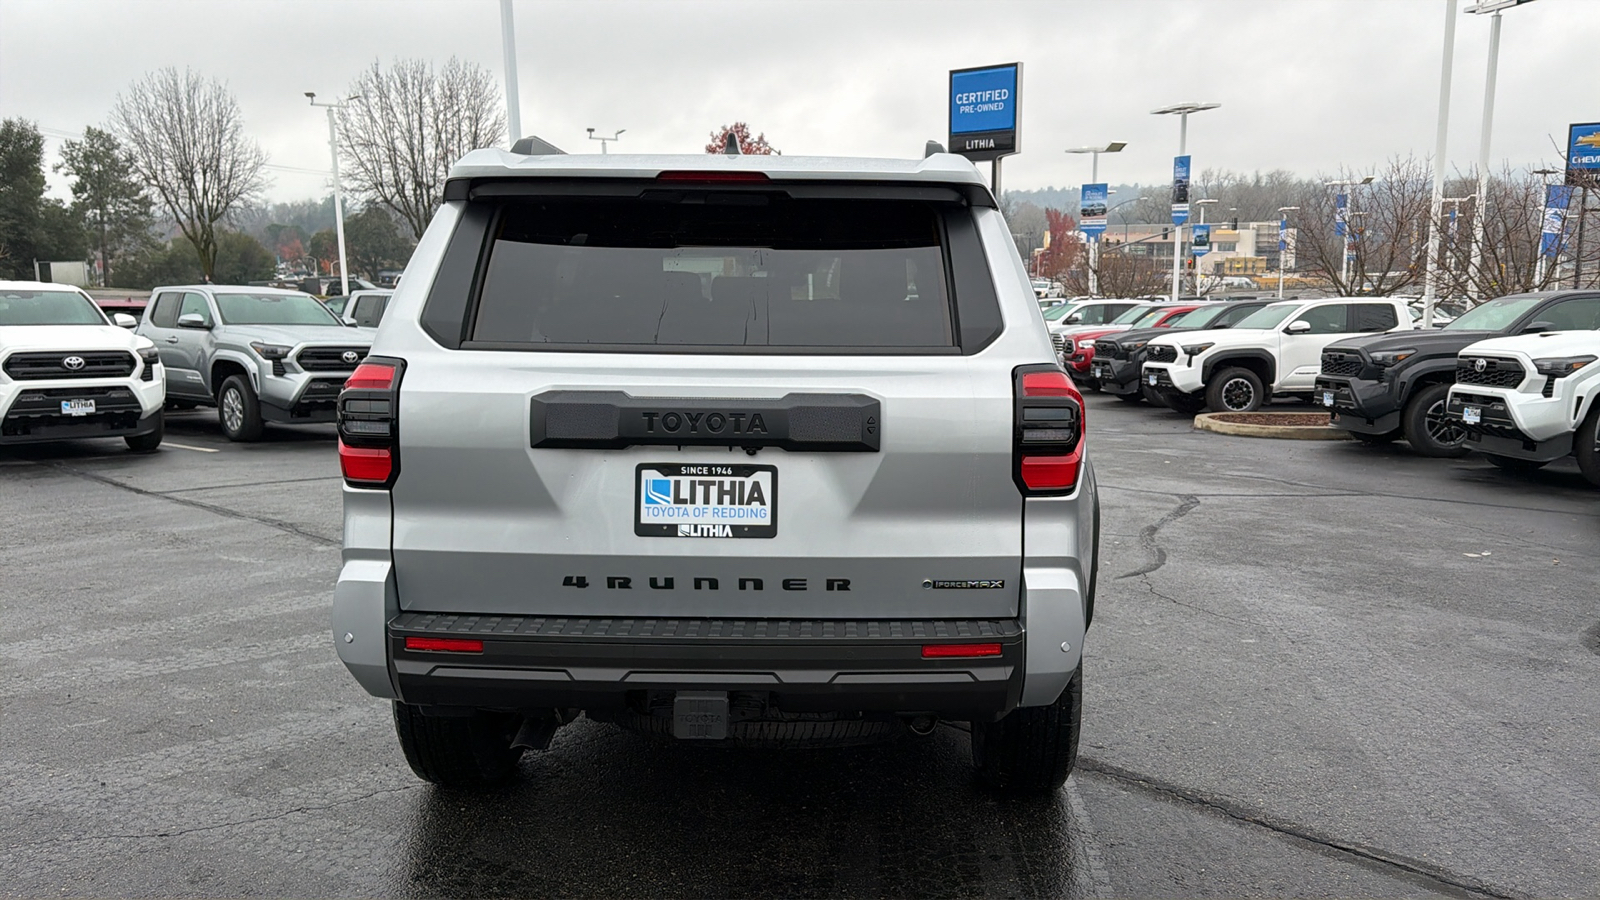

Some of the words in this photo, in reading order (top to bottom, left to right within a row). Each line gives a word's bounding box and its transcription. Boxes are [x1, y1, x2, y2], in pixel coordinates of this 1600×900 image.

[956, 89, 1008, 104] CERTIFIED
[960, 102, 1004, 113] PRE-OWNED
[966, 138, 995, 149] LITHIA
[1572, 155, 1600, 164] CHEV
[642, 412, 768, 434] TOYOTA
[681, 466, 709, 475] SINCE
[711, 466, 733, 475] 1946
[673, 479, 767, 506] LITHIA
[645, 507, 690, 518] TOYOTA
[692, 507, 710, 518] OF
[712, 507, 767, 519] REDDING
[690, 524, 733, 537] LITHIA
[678, 714, 722, 723] TOYOTA
